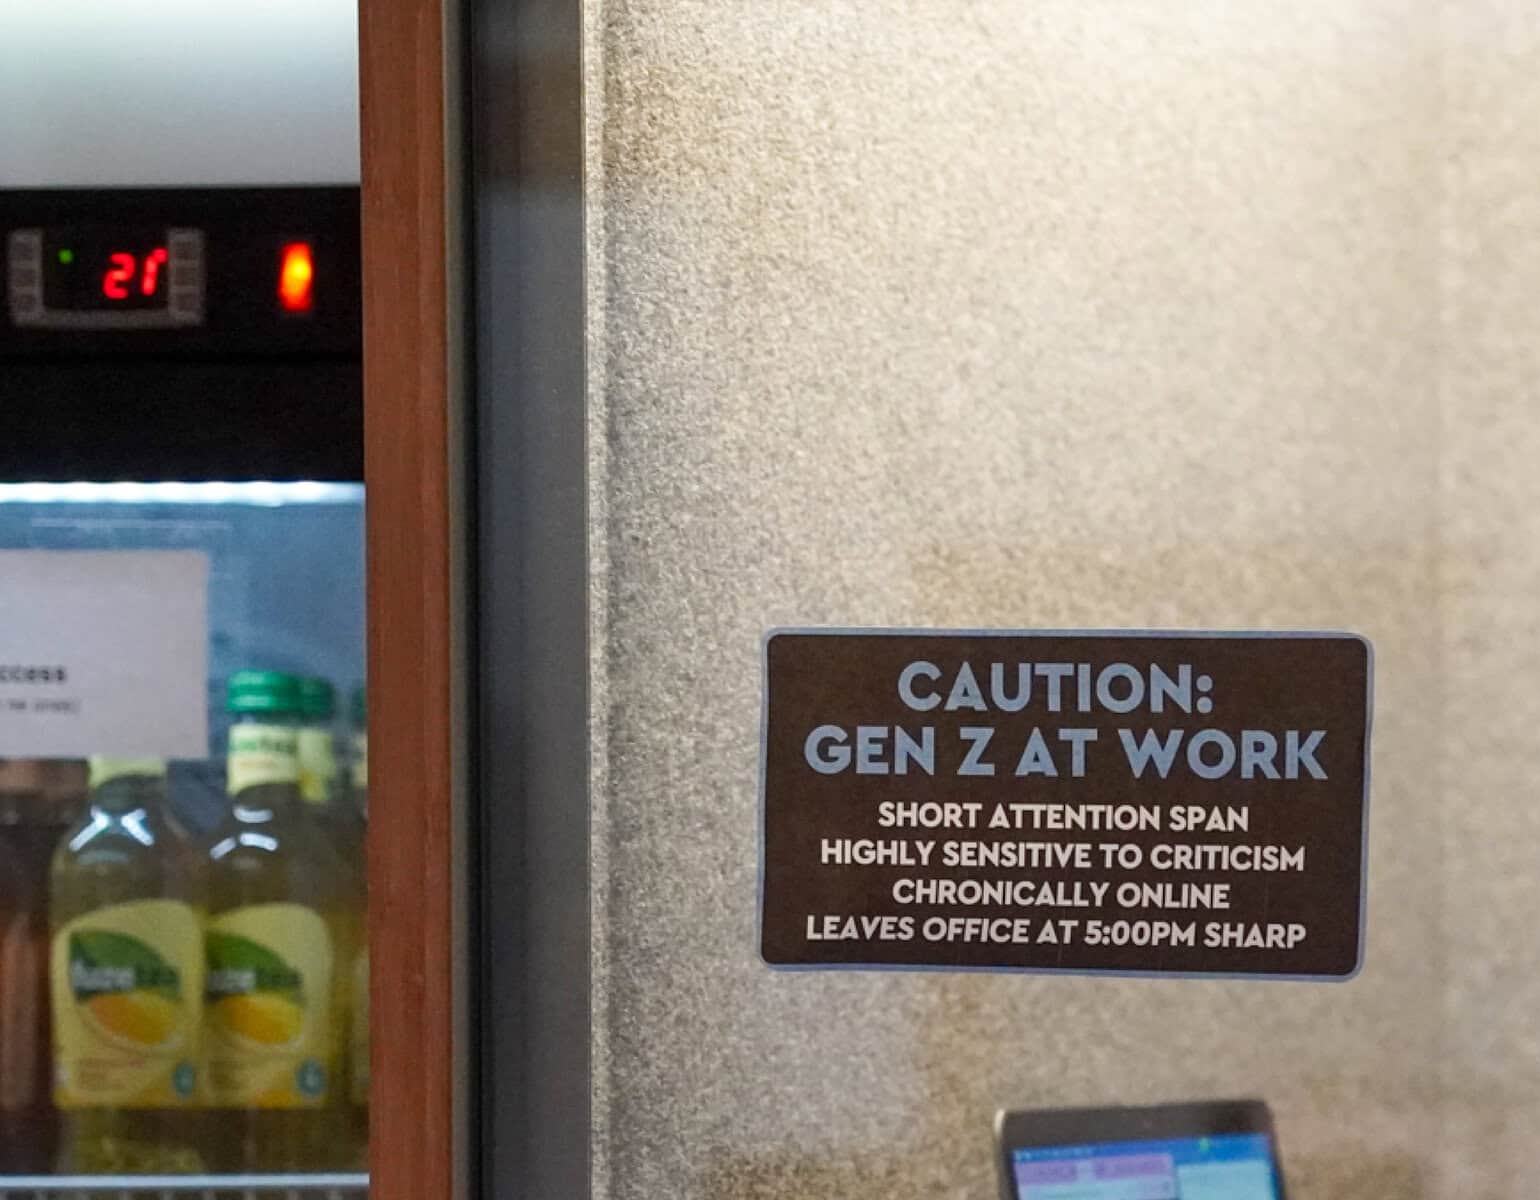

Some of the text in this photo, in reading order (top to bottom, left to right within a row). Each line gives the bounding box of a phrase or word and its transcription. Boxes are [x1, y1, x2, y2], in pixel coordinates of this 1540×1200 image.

[898, 660, 1213, 714] CAUTION:
[804, 724, 1328, 780] GEN Z AT WORK
[878, 801, 1249, 832] SHORT ATTENTION SPAN
[821, 838, 1306, 872] HIGHLY SENSITIVE TO CRITICISM
[892, 878, 1231, 910] CHRONICALLY ONLINE
[806, 914, 1307, 949] LEAVES OFFICE AT 5:00PM SHARP
